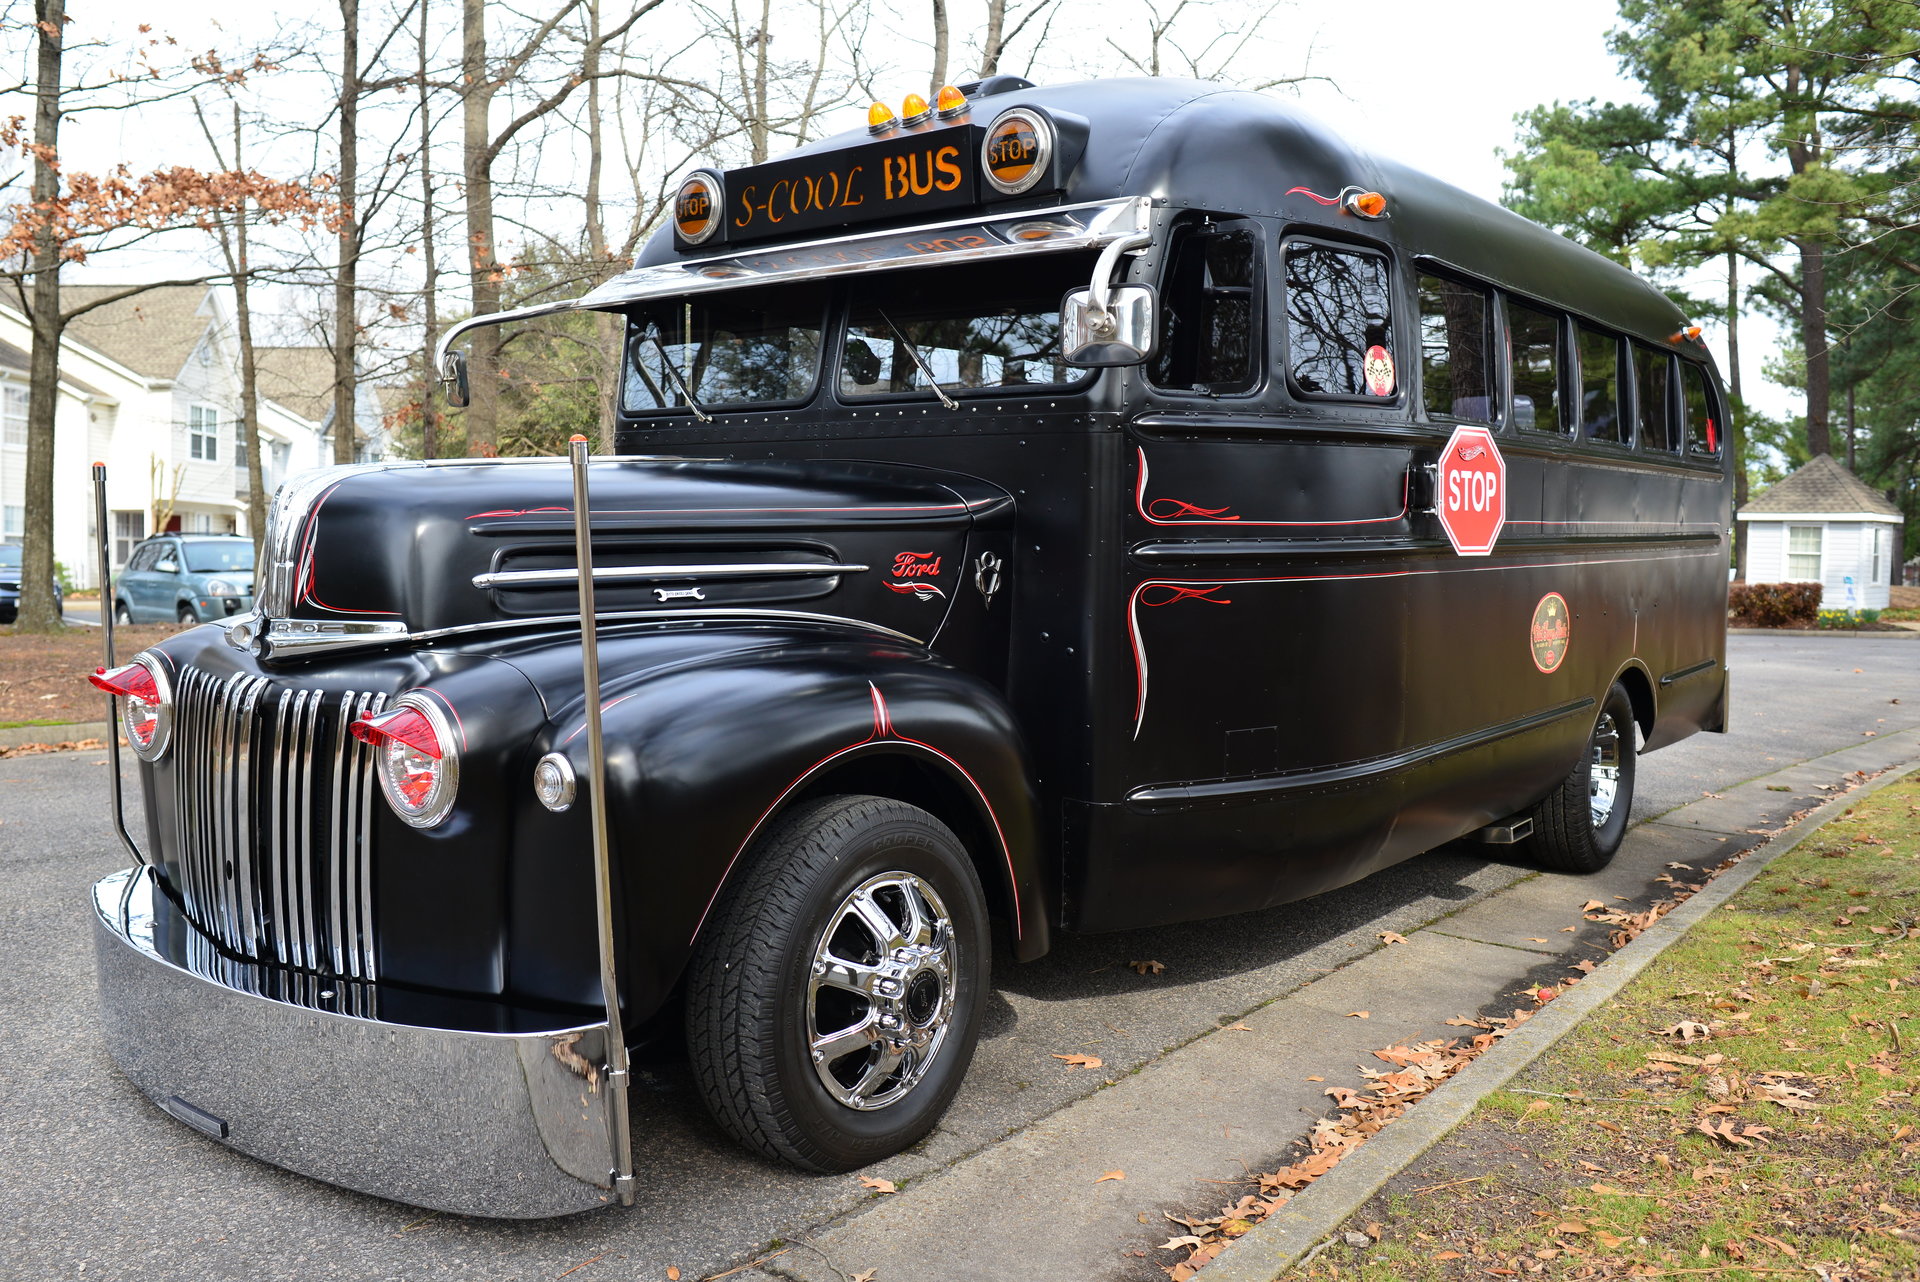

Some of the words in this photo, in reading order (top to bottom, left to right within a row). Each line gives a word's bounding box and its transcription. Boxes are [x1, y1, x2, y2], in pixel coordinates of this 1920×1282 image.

[989, 138, 1036, 165] STOP
[735, 165, 864, 227] S-COOL
[883, 146, 962, 200] BUS
[676, 197, 709, 219] STOP
[1449, 469, 1497, 512] STOP
[891, 551, 942, 578] Ford
